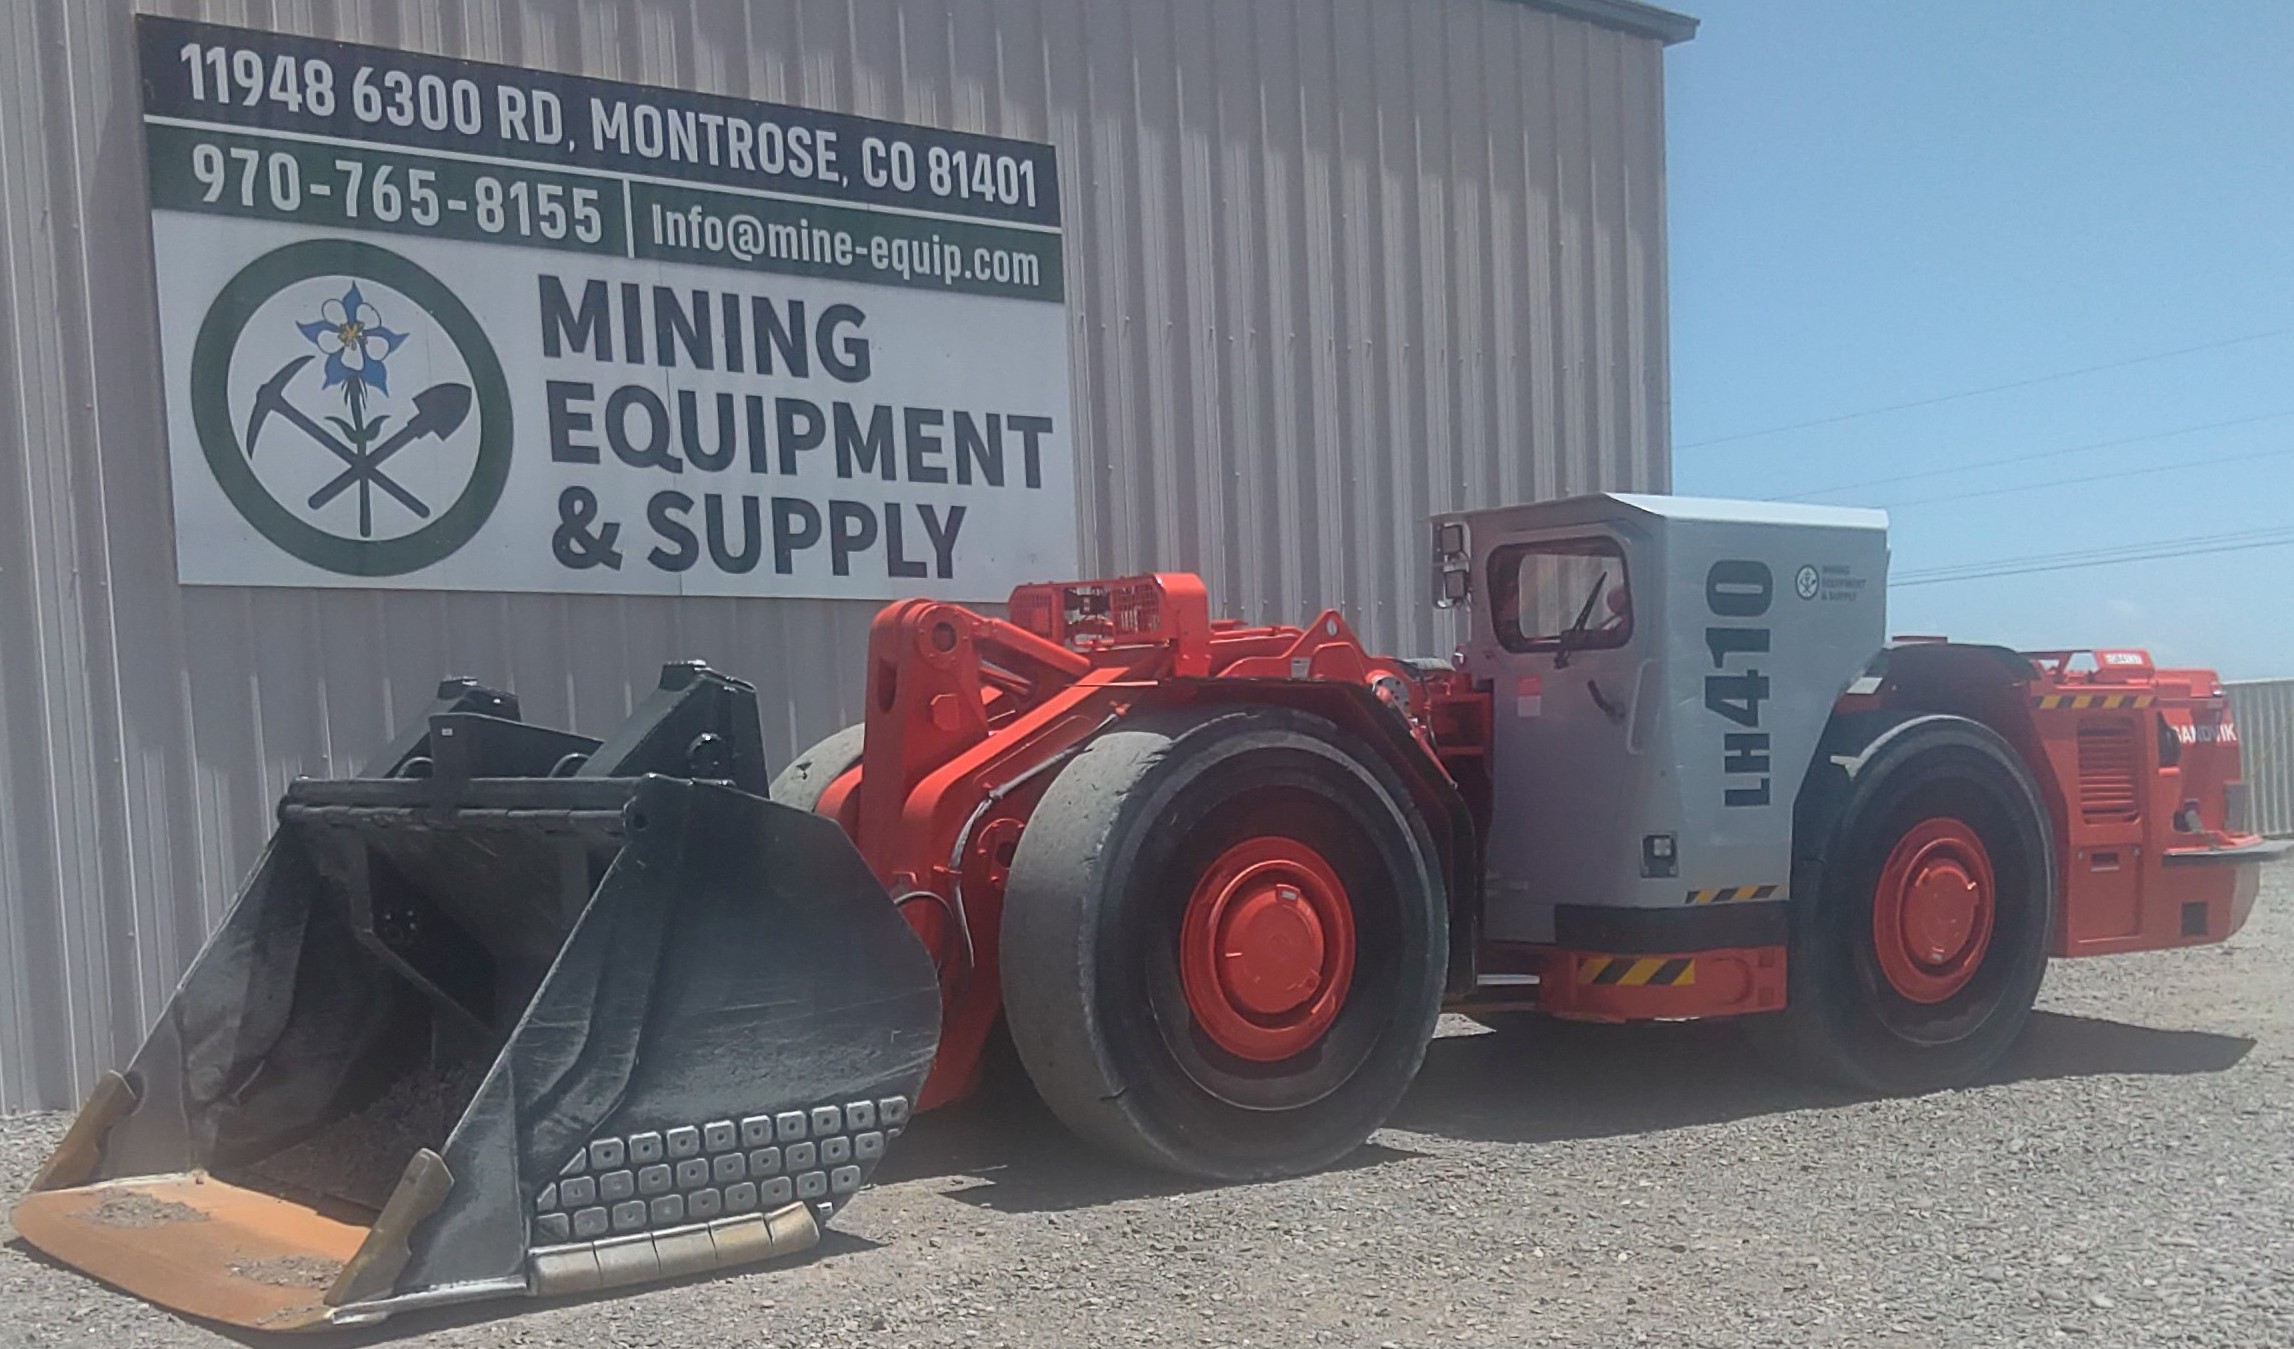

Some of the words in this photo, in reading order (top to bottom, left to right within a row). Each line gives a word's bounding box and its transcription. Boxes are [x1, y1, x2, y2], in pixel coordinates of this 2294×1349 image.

[180, 43, 335, 117] 11948
[352, 66, 482, 135] 6300
[498, 85, 575, 153] RD,
[591, 97, 849, 188] MONTROSE,
[861, 137, 916, 192] CO
[928, 146, 1037, 208] 81401
[193, 143, 602, 243] 970-765-8155
[652, 203, 1040, 286] Info@mine-equip.com
[538, 274, 871, 383] MINING
[546, 379, 1054, 489] EQUIPMENT
[551, 485, 623, 571] &
[646, 489, 967, 579] SUPPLY
[1705, 560, 1773, 806] LH410
